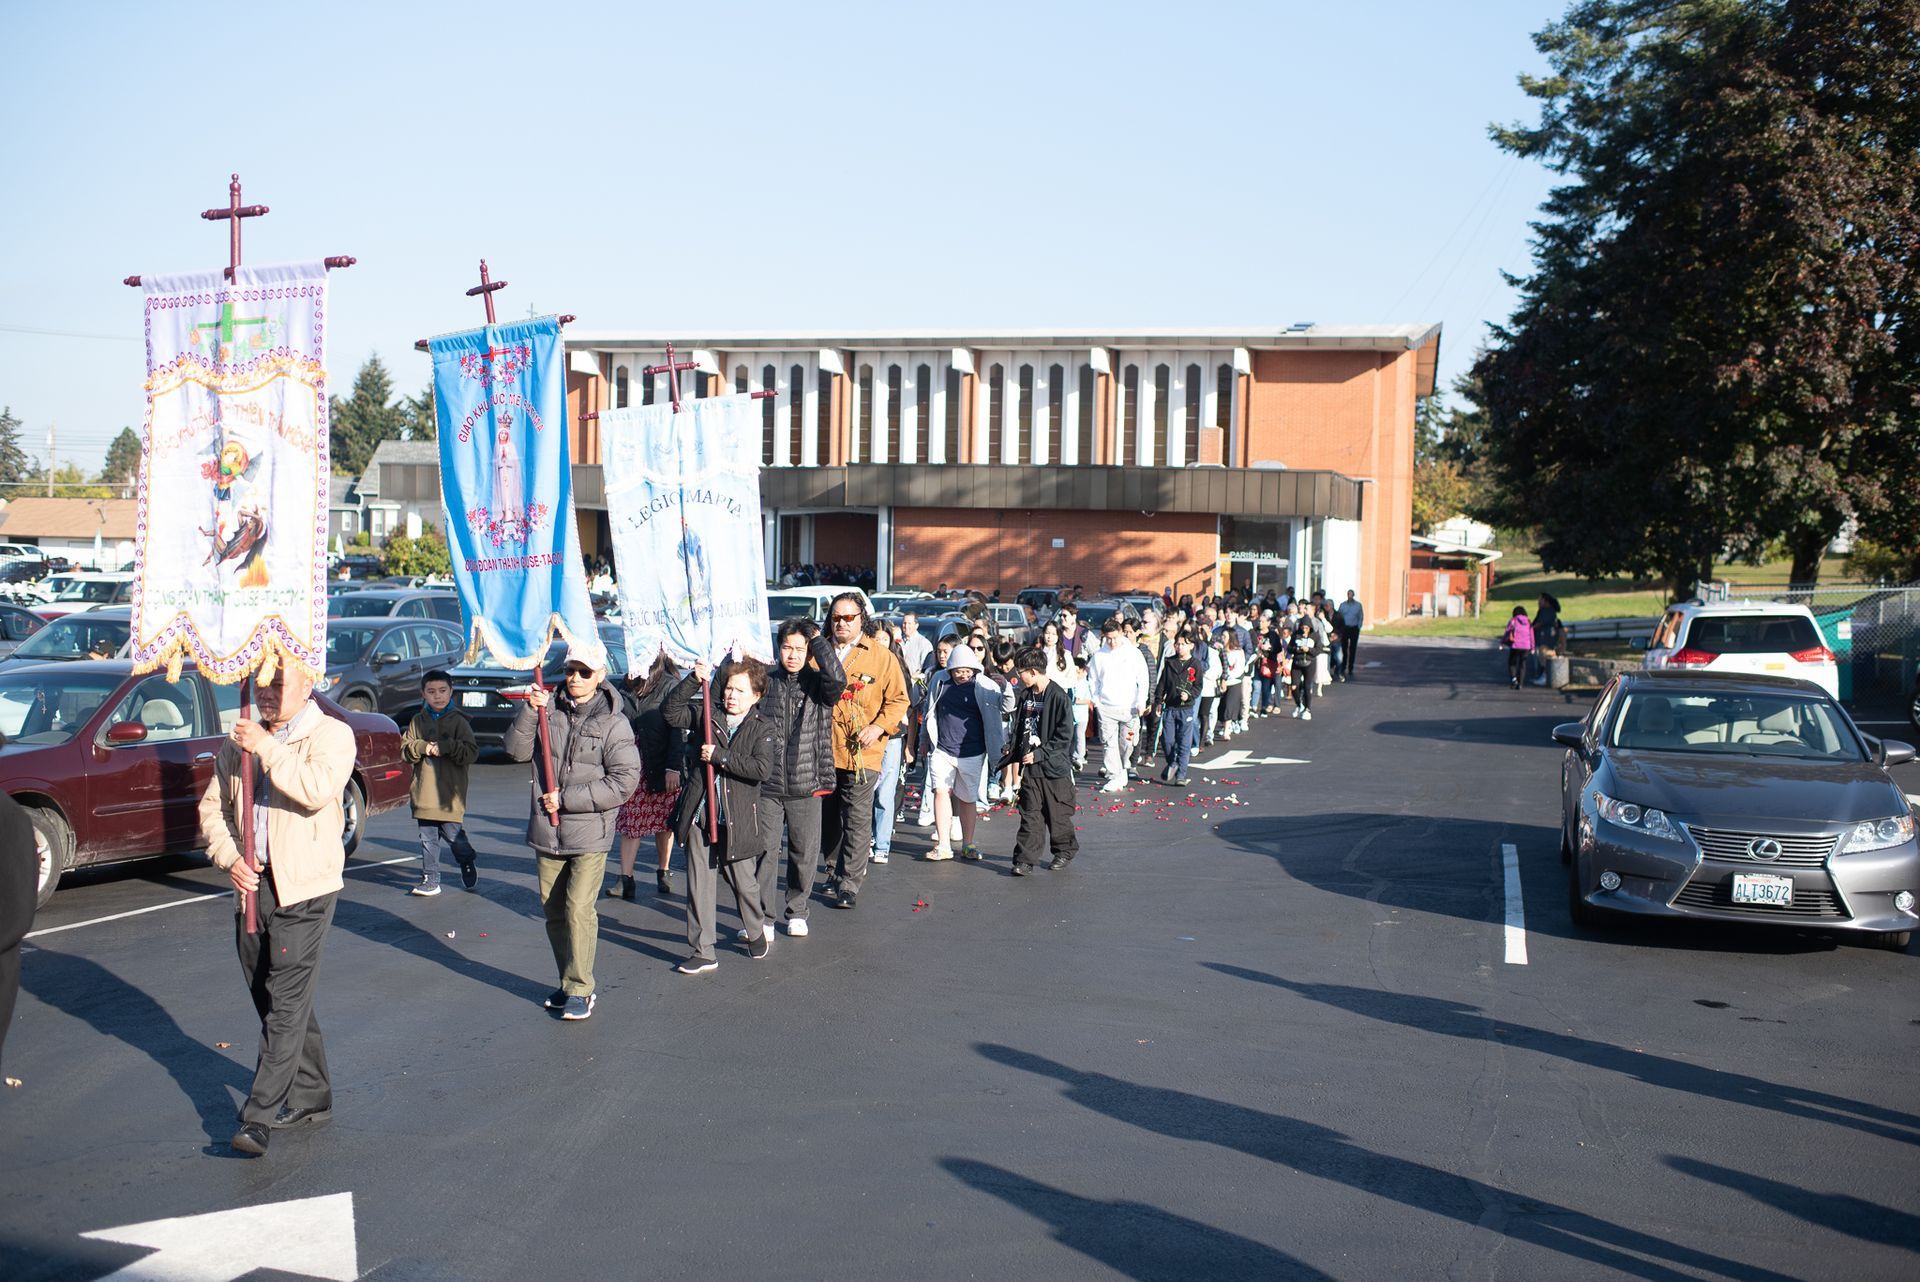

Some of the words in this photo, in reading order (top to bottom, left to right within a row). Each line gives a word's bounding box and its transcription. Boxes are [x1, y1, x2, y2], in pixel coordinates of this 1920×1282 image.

[1230, 550, 1259, 560] PARISH
[1260, 551, 1280, 561] HALL
[1736, 884, 1789, 900] ALT3672
